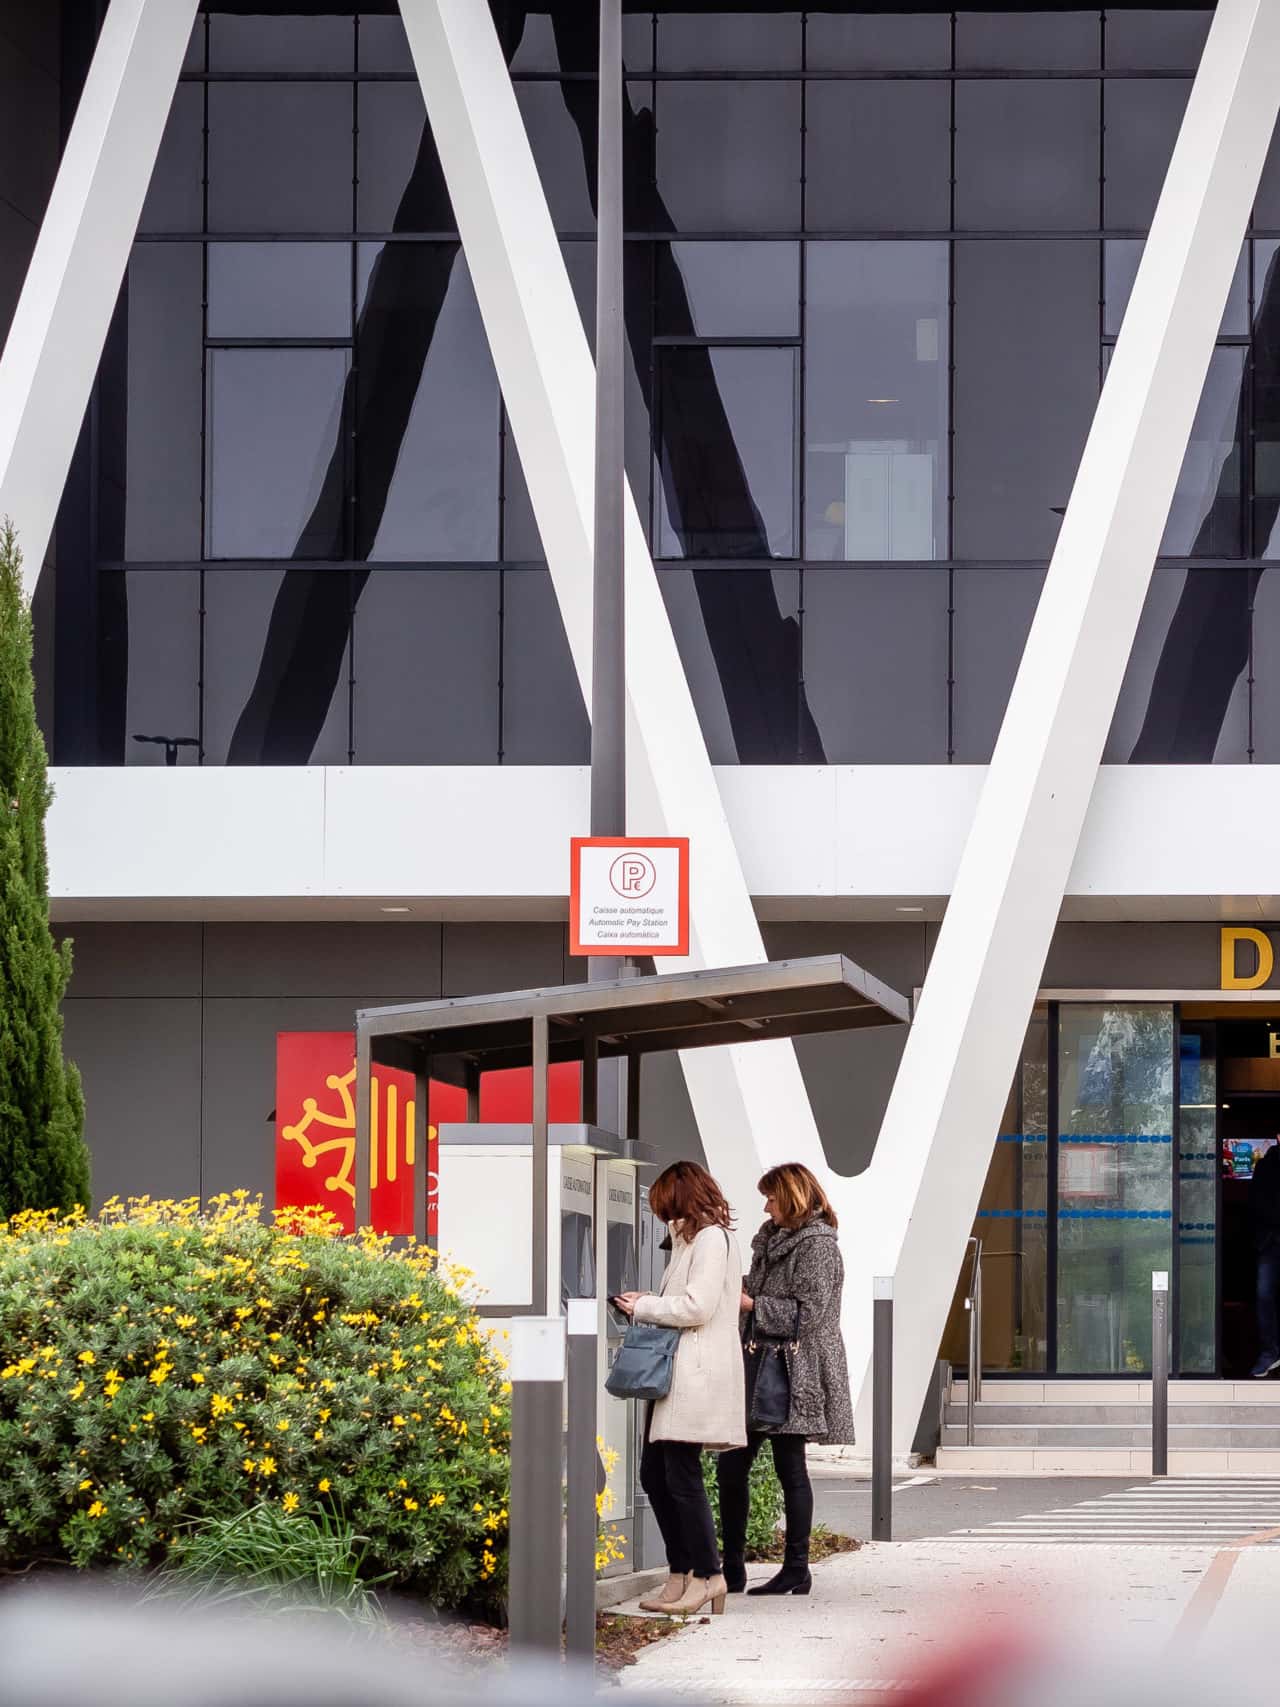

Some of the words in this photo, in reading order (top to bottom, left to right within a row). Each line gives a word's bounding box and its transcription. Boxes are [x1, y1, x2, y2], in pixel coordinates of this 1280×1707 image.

[593, 906, 618, 915] Caisse
[619, 906, 664, 916] automatique
[588, 918, 625, 926] Automatic
[627, 918, 641, 928] Pay
[642, 918, 668, 926] Station
[597, 930, 618, 938] Caixa
